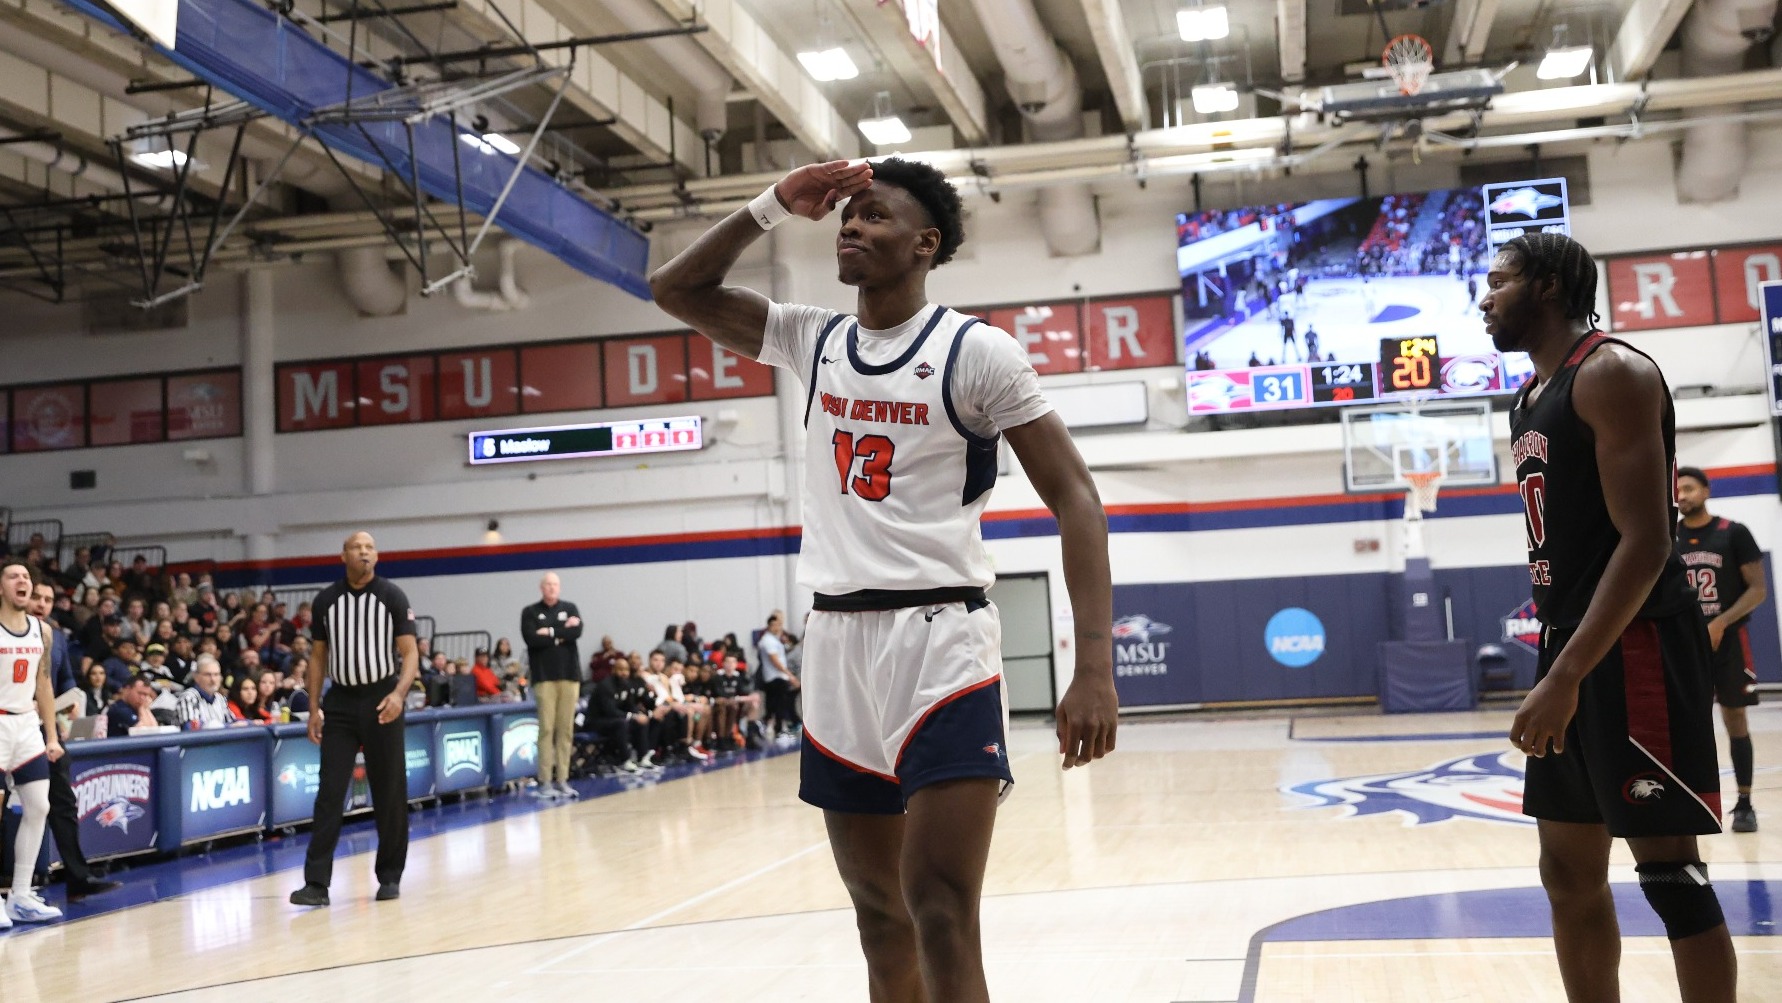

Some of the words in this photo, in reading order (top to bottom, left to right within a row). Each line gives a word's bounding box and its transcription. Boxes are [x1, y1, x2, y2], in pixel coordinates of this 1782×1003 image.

[1262, 375, 1295, 401] 31
[1321, 363, 1364, 387] 1:24
[1392, 355, 1431, 389] 20
[849, 399, 930, 425] DENVER
[832, 428, 895, 502] 13
[1686, 568, 1718, 602] 12
[1505, 617, 1543, 638] RMA
[1115, 641, 1166, 664] MSU
[1271, 634, 1325, 654] NCAA
[13, 659, 29, 684] 0
[190, 764, 252, 813] NCAA
